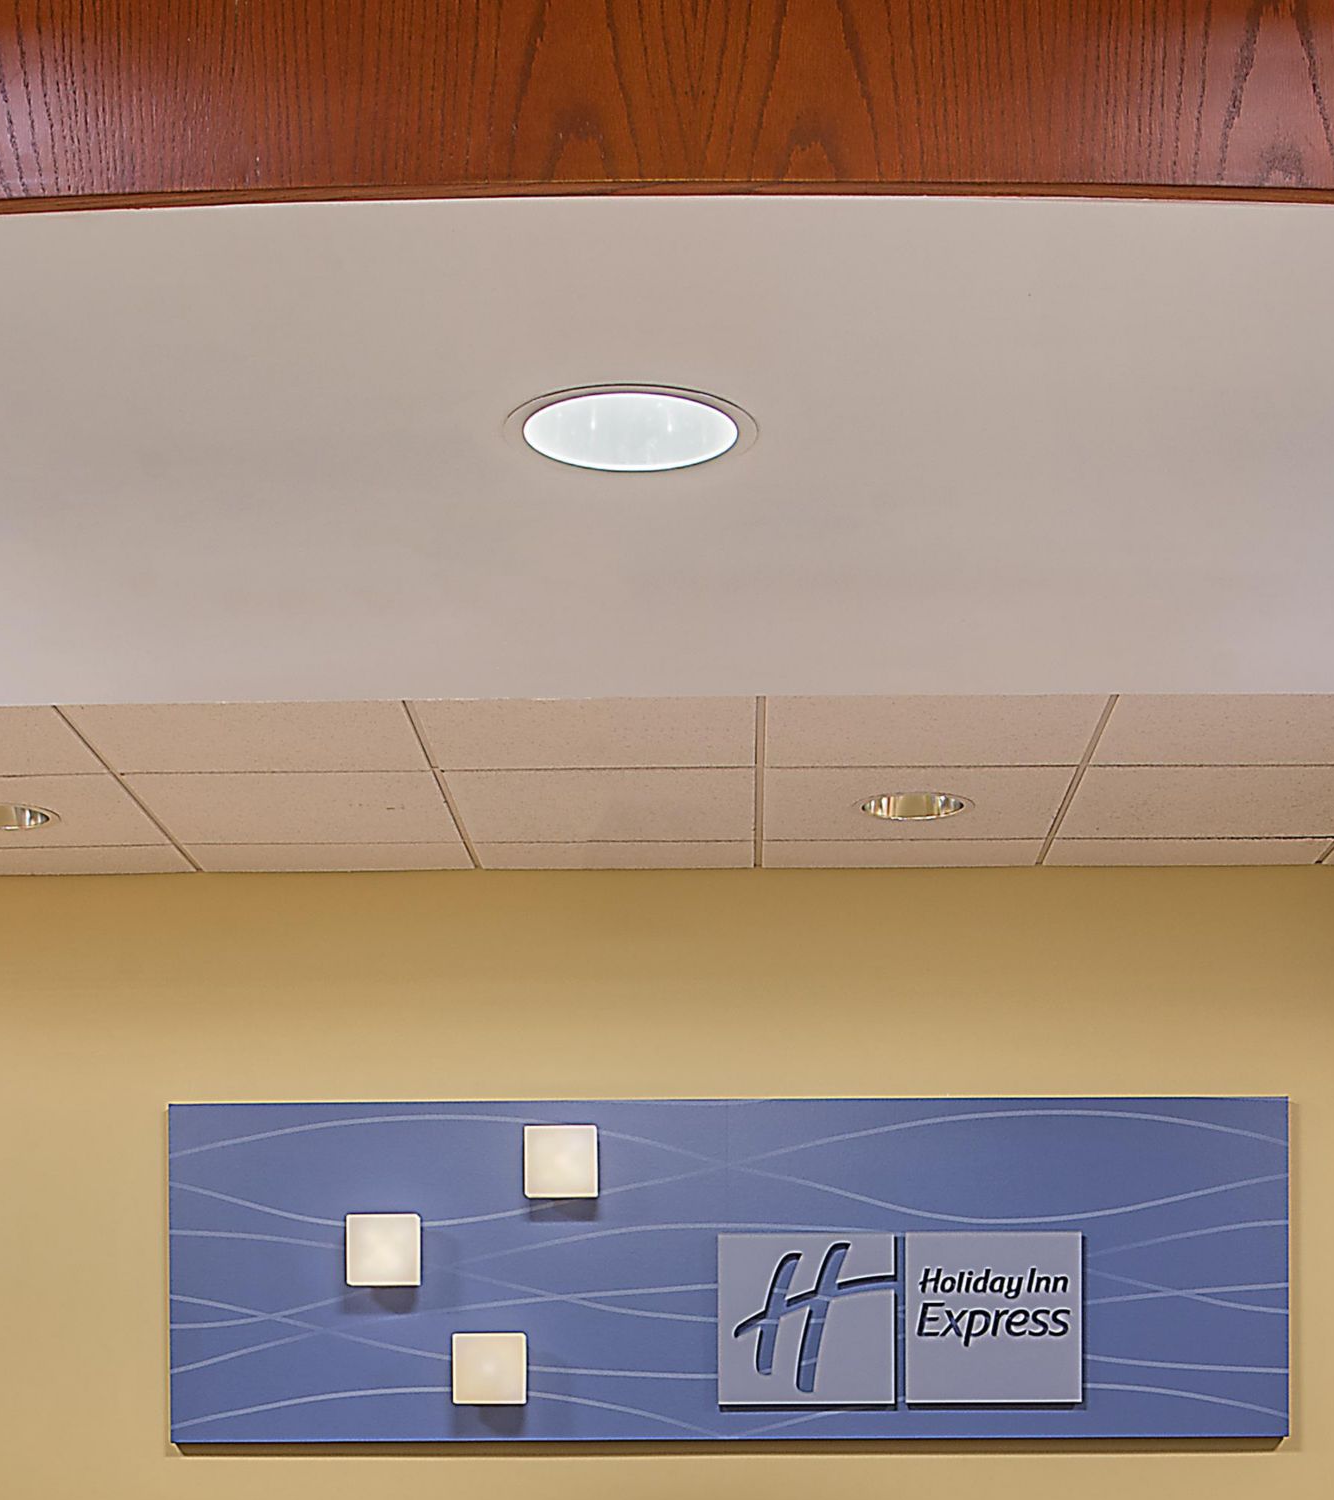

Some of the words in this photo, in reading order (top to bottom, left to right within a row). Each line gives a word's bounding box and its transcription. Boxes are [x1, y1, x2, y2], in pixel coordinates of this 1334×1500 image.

[918, 1267, 1024, 1299] Holiday
[1027, 1267, 1069, 1293] Inn
[916, 1302, 1071, 1347] Express
